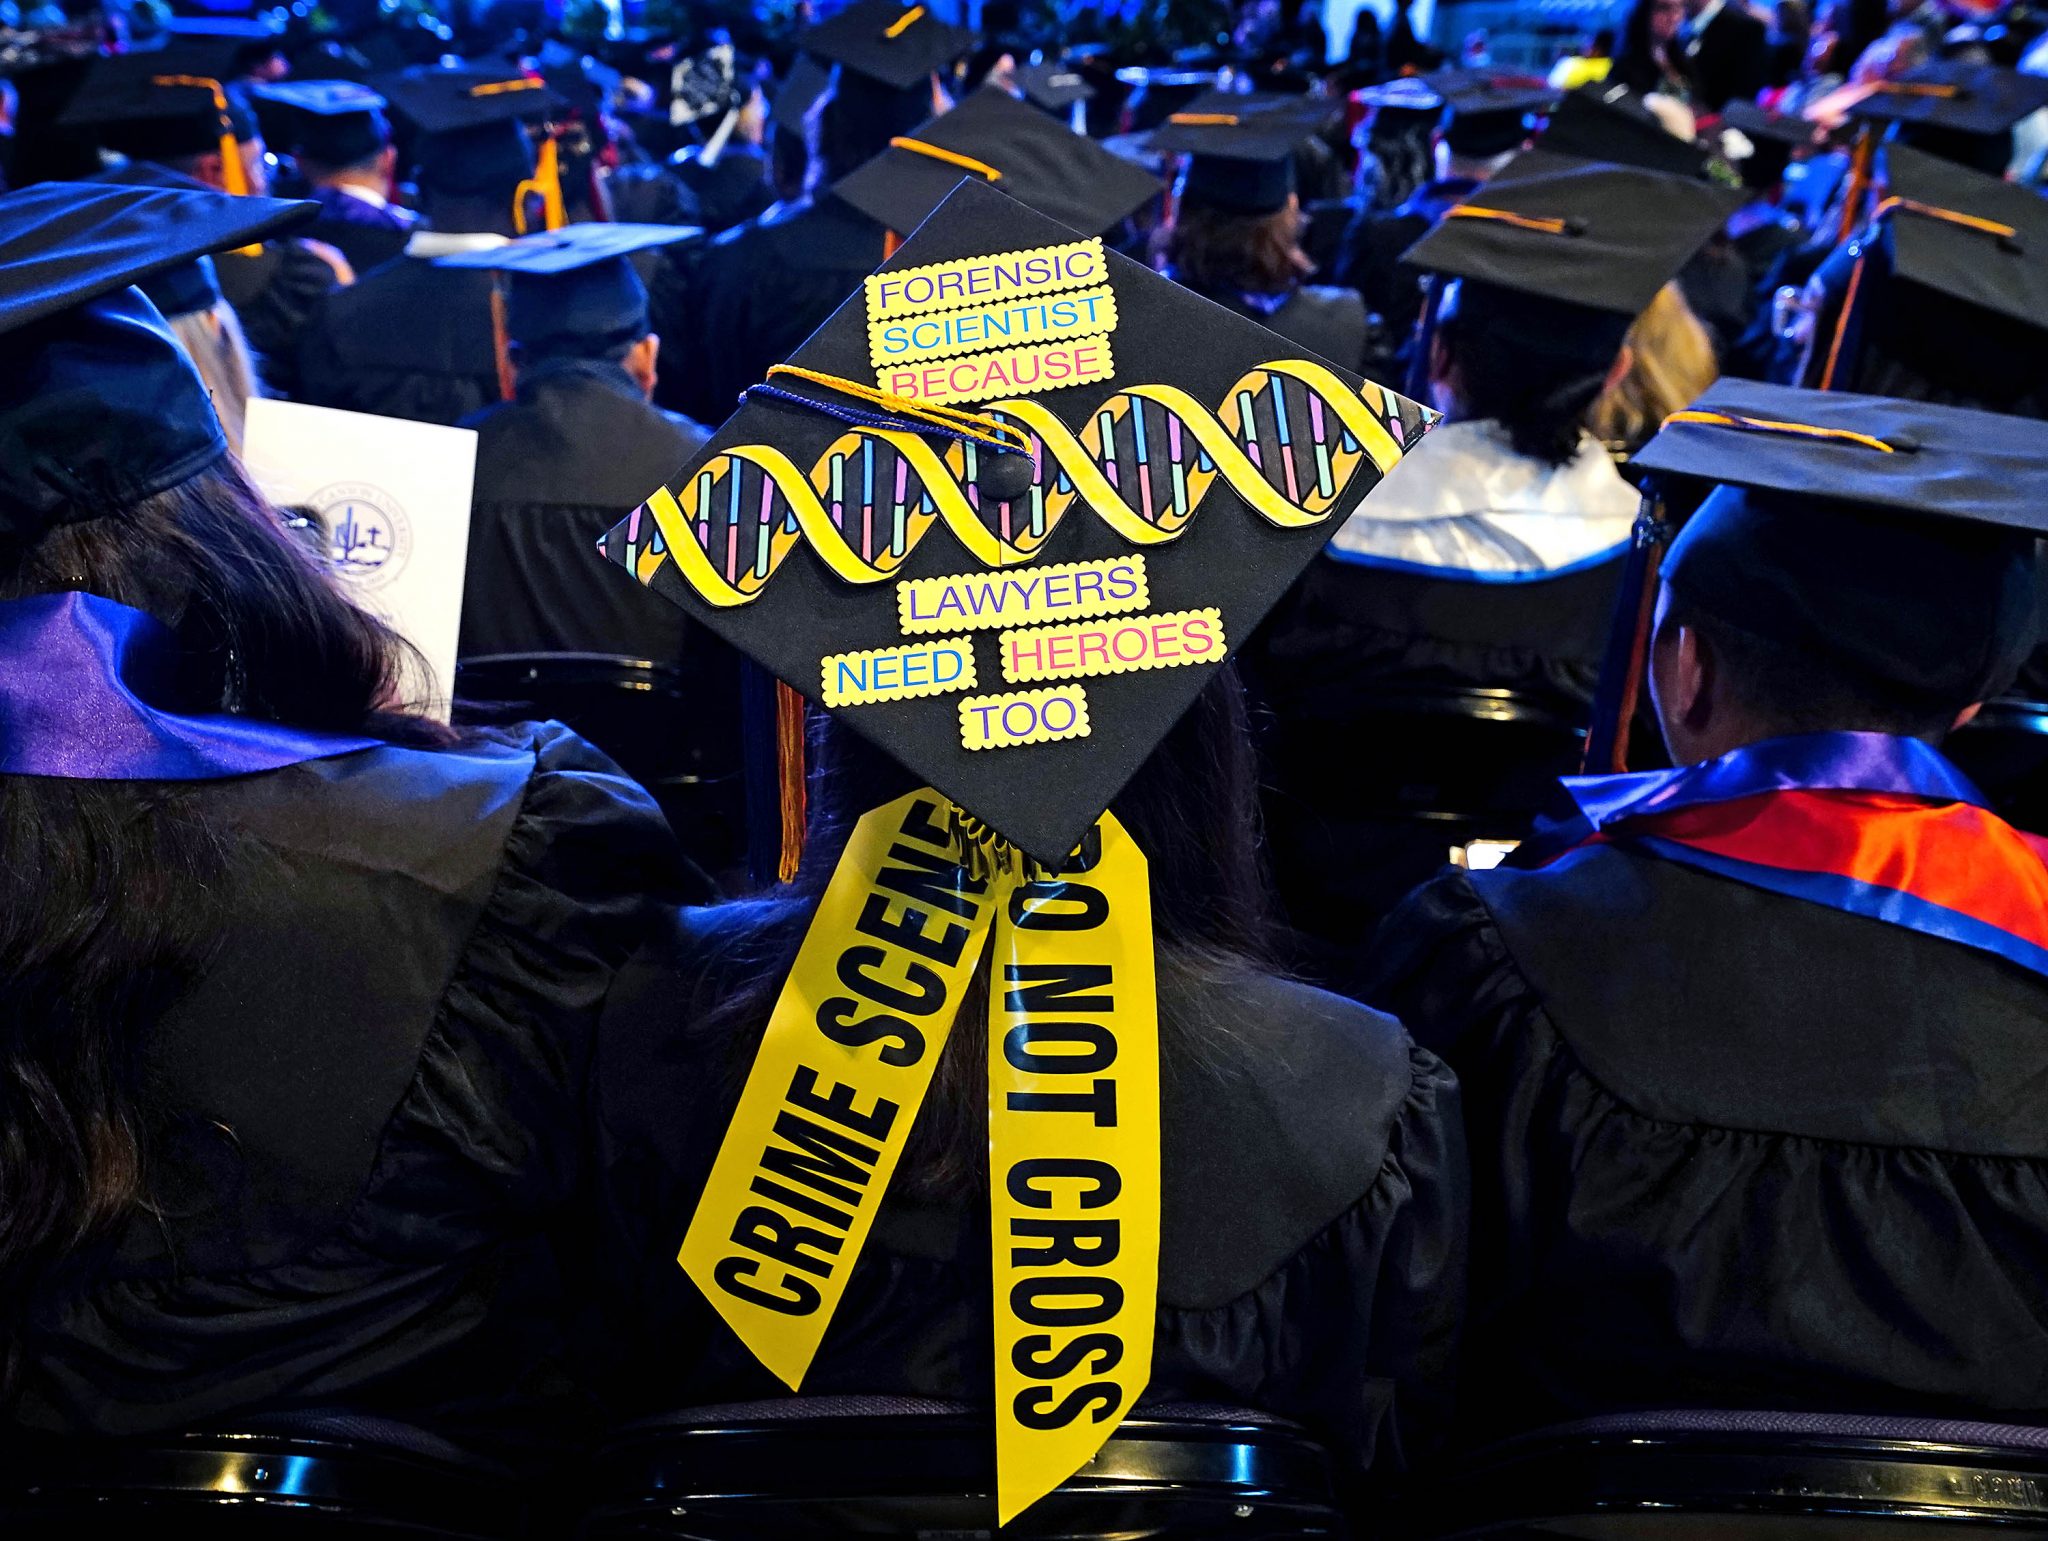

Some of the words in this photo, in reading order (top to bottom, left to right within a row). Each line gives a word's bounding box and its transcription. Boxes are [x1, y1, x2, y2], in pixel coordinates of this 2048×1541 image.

[881, 251, 1095, 309] FORENSIC
[883, 295, 1104, 353] SCIENTIST
[892, 346, 1101, 399] BECAUSE
[910, 565, 1138, 621] LAWYERS
[838, 649, 963, 694] NEED
[1012, 619, 1213, 673] HEROES
[970, 697, 1077, 740] TOO
[1003, 964, 1118, 1128] NOT
[713, 1064, 900, 1317] CRIME
[1006, 1158, 1124, 1431] CROSS
